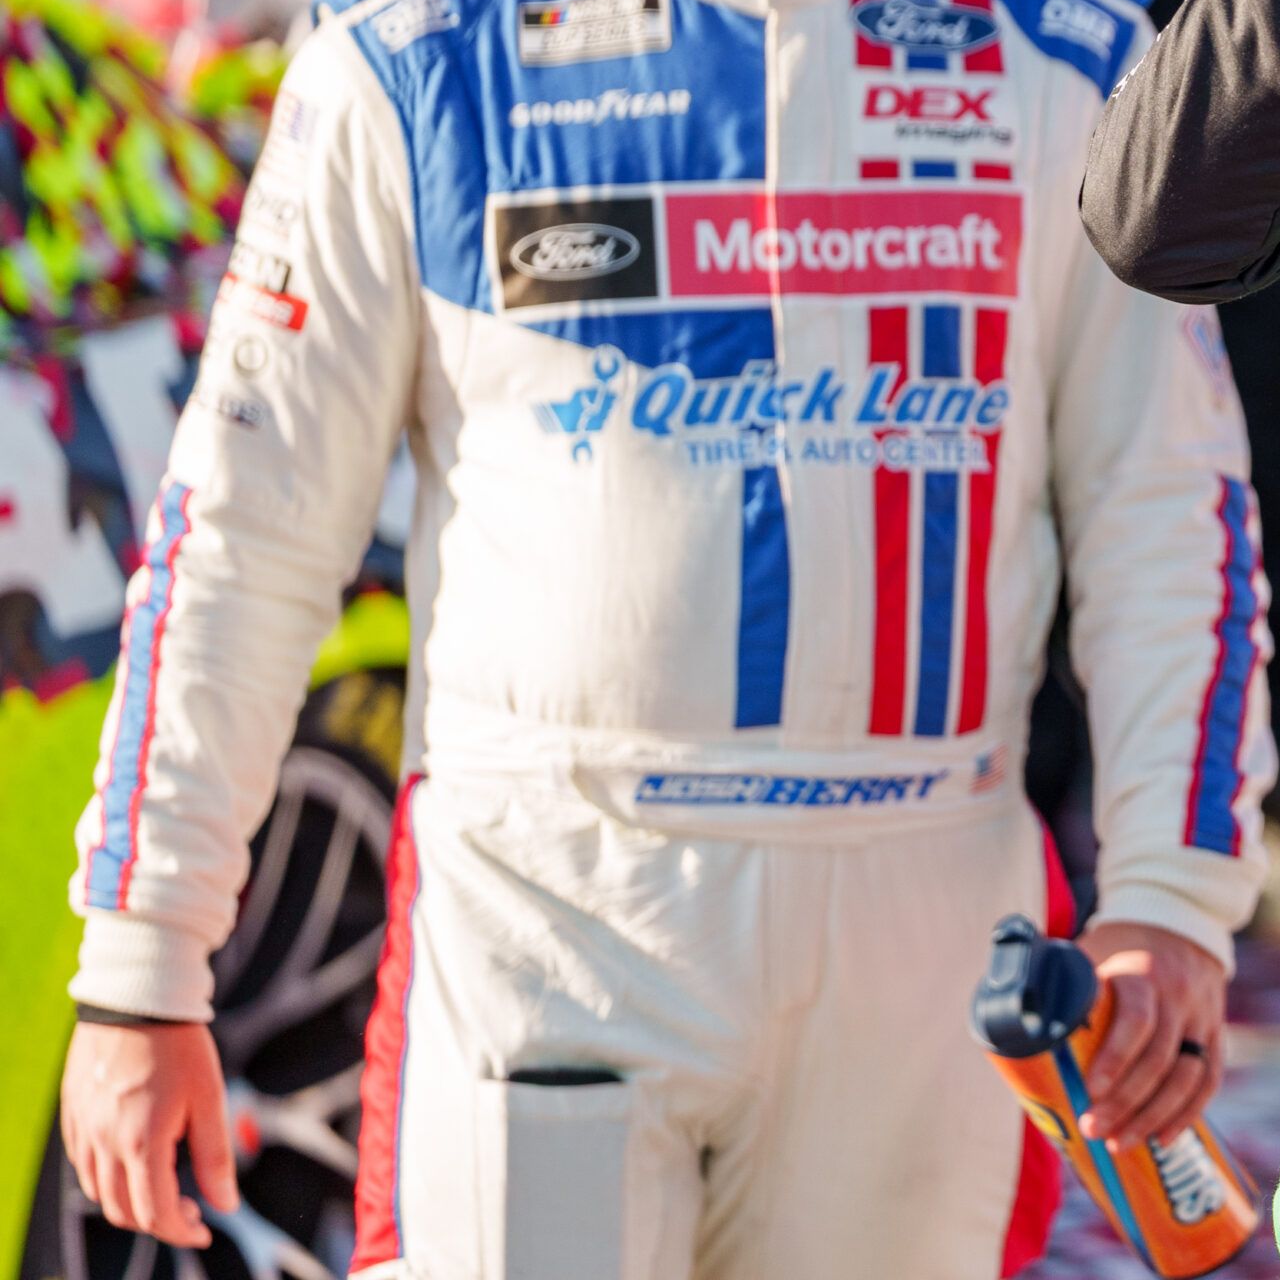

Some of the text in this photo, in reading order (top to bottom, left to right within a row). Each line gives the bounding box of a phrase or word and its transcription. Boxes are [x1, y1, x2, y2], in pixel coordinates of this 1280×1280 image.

[876, 0, 971, 46] Ford
[509, 88, 691, 128] GOODYEAR
[863, 86, 994, 121] DEX
[531, 213, 1002, 274] Ford Motorcraft
[630, 357, 1011, 437] Quick Lane
[682, 437, 748, 464] TIRE
[803, 436, 878, 462] AUTO
[880, 436, 989, 472] CENTER
